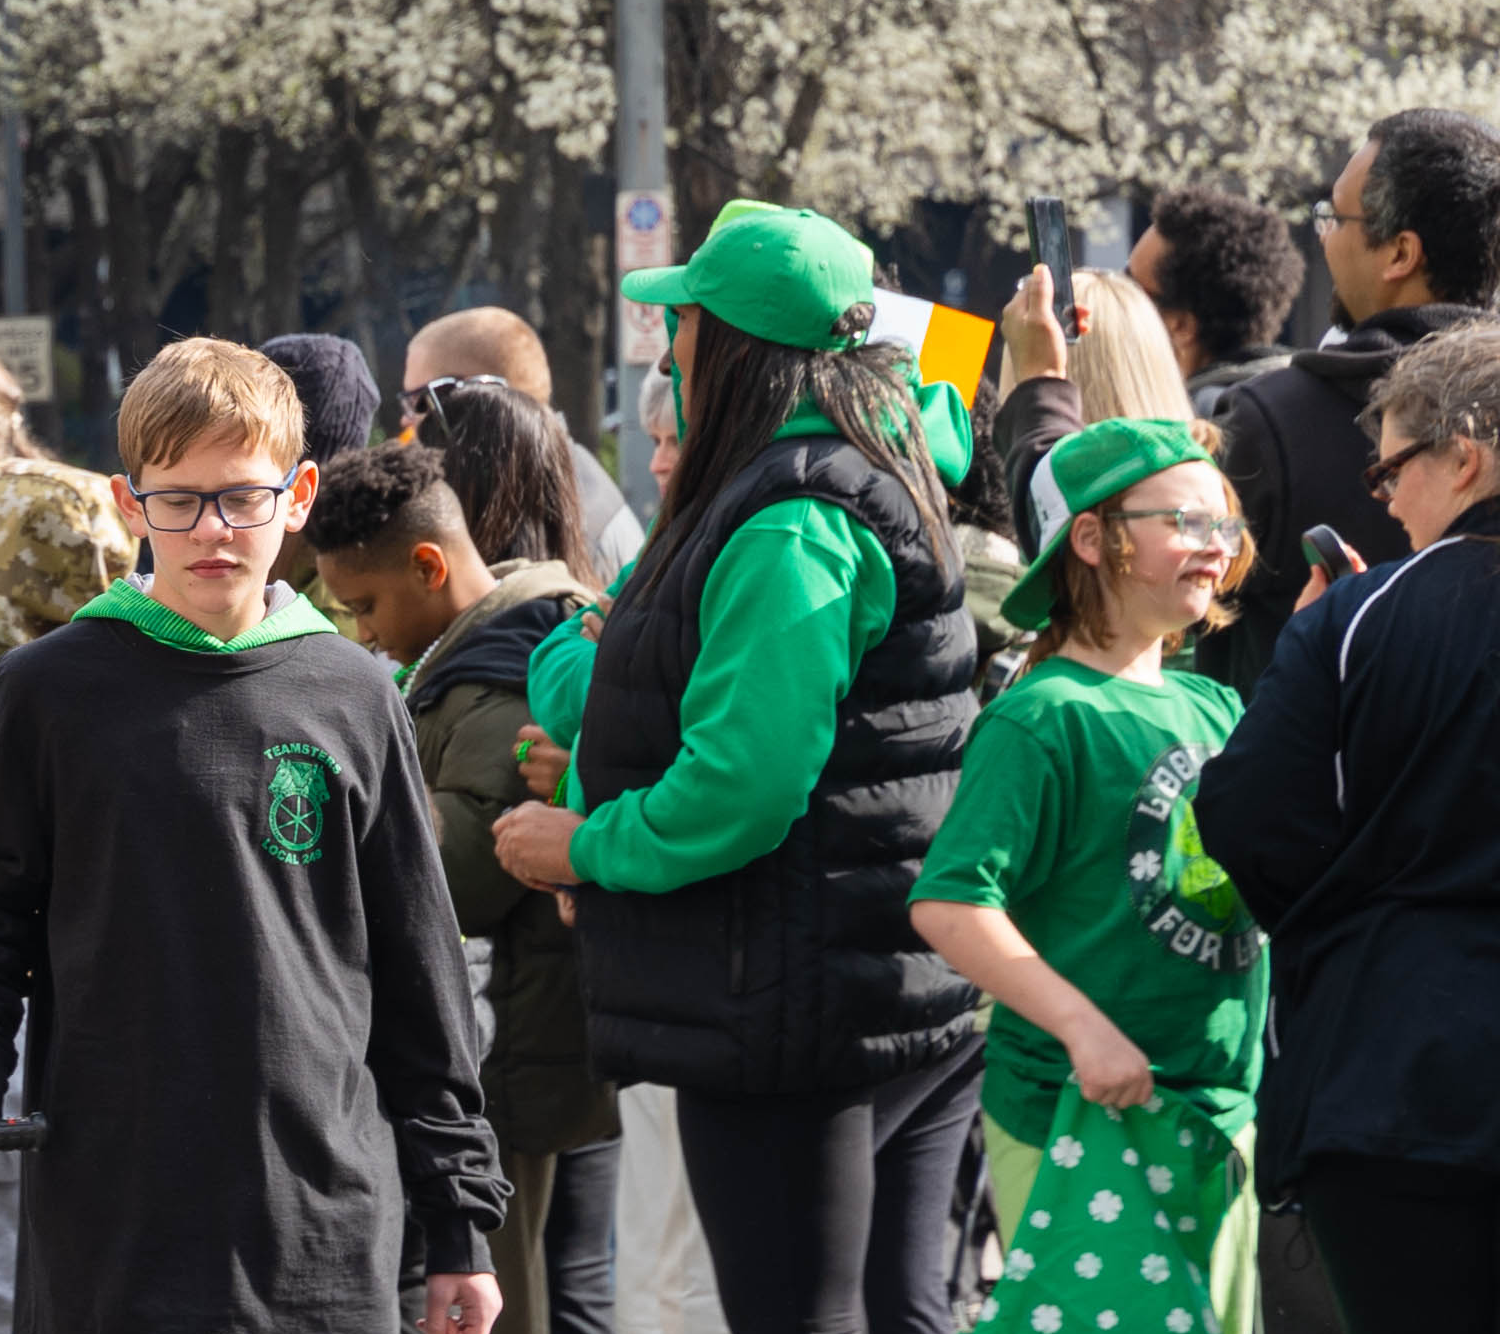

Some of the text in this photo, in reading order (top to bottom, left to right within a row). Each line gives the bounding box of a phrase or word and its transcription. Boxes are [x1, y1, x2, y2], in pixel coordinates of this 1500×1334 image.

[263, 743, 342, 775] TEAMSTERS
[261, 837, 300, 865] LOCAL
[1150, 905, 1223, 970] FOR
